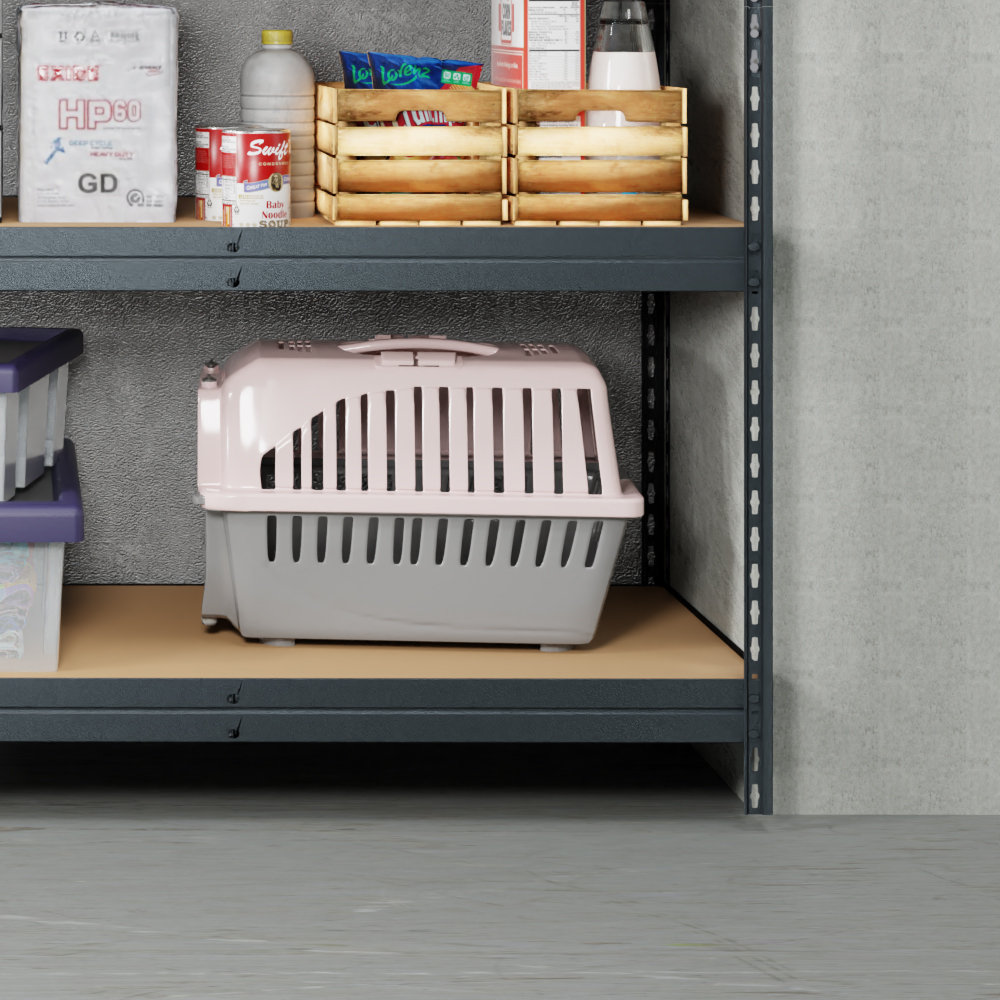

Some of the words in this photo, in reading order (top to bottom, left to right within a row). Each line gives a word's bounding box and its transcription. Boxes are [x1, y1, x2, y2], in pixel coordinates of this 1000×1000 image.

[380, 63, 431, 86] Lorenz
[58, 99, 142, 130] HP60
[247, 139, 289, 160] Swift
[78, 173, 118, 193] GD
[266, 200, 284, 209] Baby
[262, 211, 287, 219] Noodle
